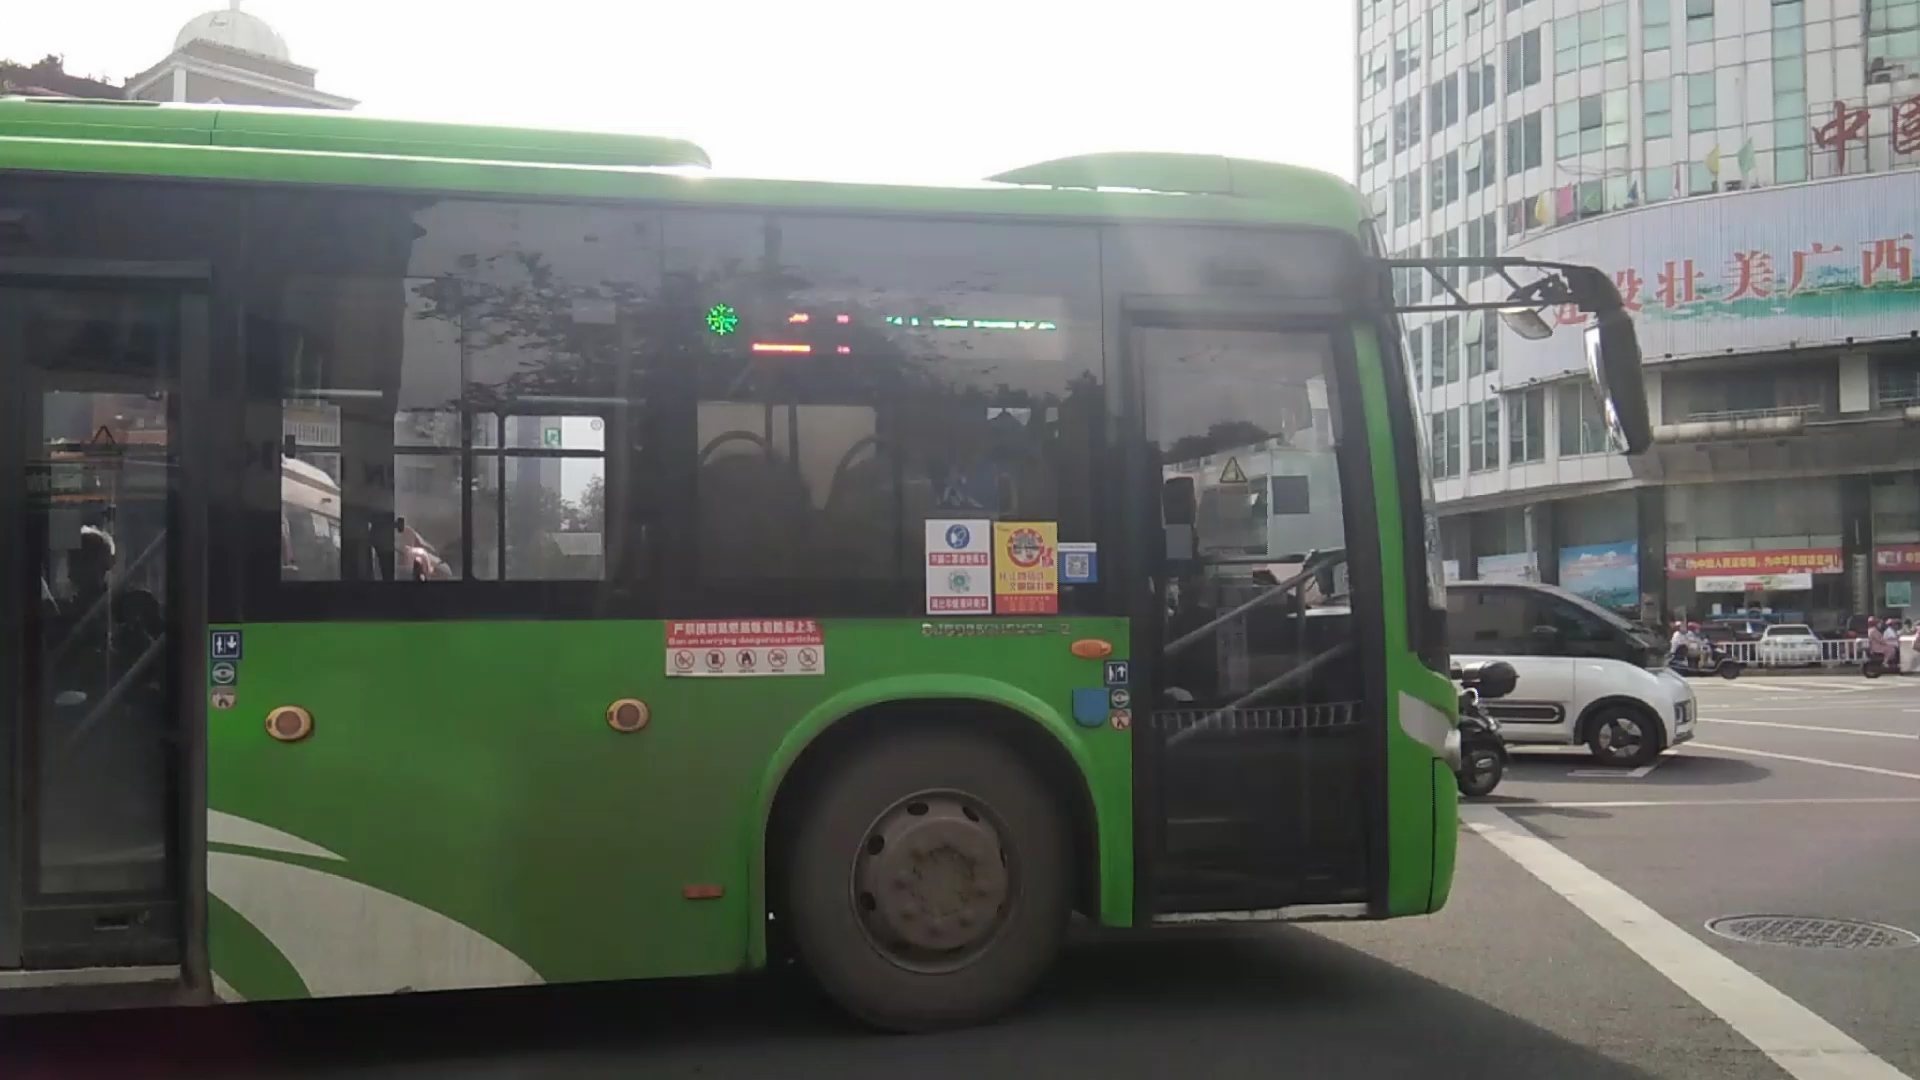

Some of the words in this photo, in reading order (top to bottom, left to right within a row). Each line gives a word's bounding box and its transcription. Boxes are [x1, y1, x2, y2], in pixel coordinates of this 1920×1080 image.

[1555, 232, 1915, 326] 设壮美广西
[699, 637, 737, 646] carrying
[738, 636, 786, 645] dangerous
[787, 635, 820, 644] articles
